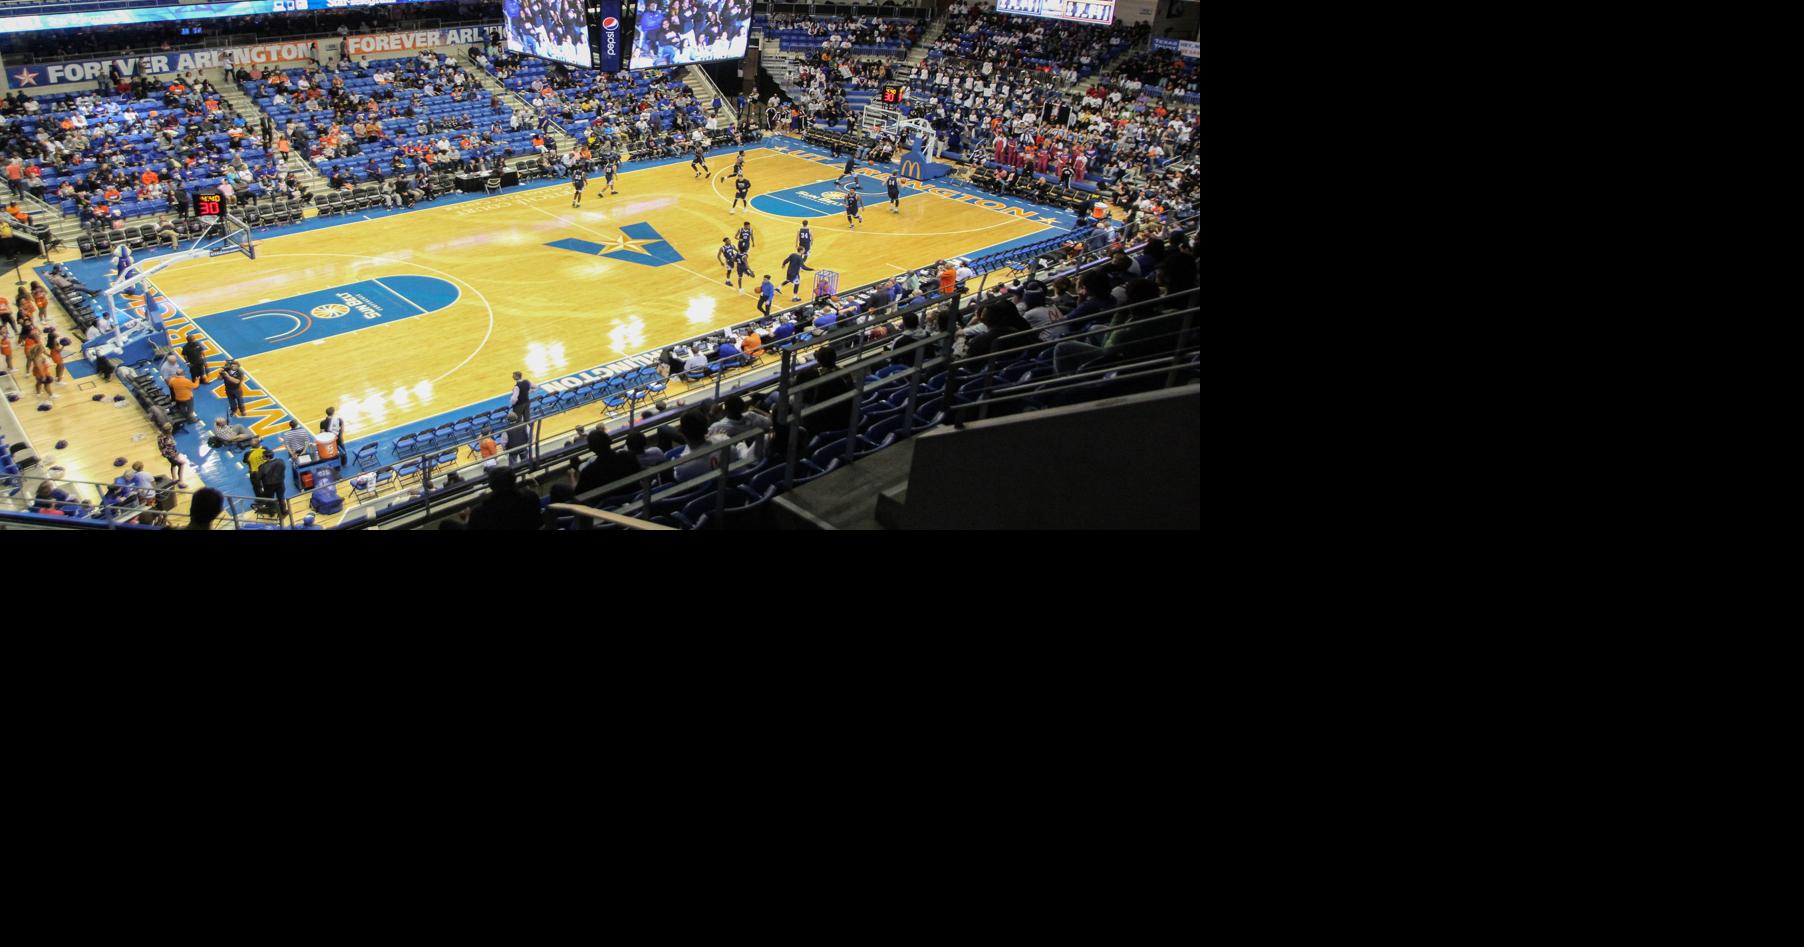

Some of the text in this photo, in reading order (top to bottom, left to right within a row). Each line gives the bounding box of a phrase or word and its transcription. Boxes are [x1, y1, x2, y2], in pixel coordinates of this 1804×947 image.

[349, 31, 441, 54] FOREVER
[605, 31, 617, 56] pepsi
[177, 42, 316, 71] ARLNGTON
[884, 92, 895, 102] 30
[199, 202, 220, 215] 30
[119, 283, 295, 439] MAVERICK
